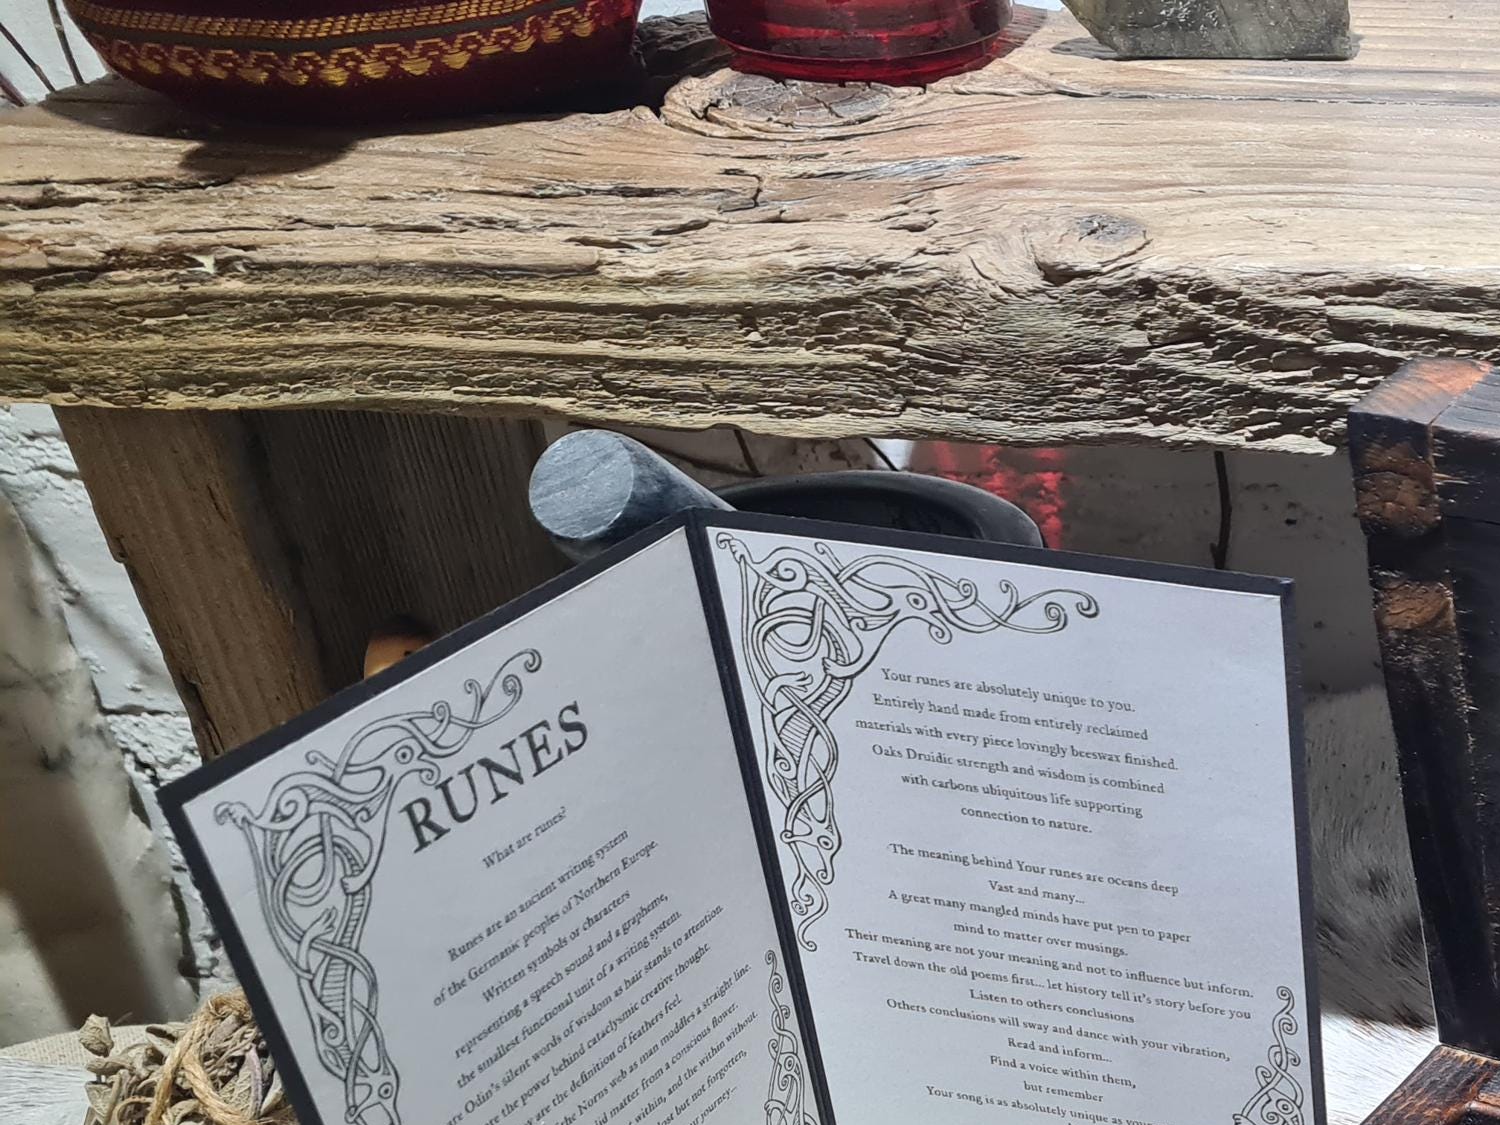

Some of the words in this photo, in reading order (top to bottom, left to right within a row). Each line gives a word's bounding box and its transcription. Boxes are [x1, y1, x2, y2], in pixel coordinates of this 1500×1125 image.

[871, 690, 926, 714] Entirely
[927, 698, 961, 716] hand
[962, 705, 998, 721] made
[999, 707, 1033, 726] from
[1033, 716, 1084, 735] entirely
[1086, 721, 1150, 741] reclaimed
[880, 665, 913, 683] Your
[915, 674, 952, 689] runes
[953, 679, 974, 691] are
[975, 678, 1041, 704] absolutely
[1042, 689, 1088, 708] unique
[1090, 695, 1106, 708] to
[1106, 698, 1137, 713] you.
[855, 717, 914, 735] materials
[914, 722, 945, 739] with
[945, 730, 981, 747] every
[982, 732, 1015, 749] piece
[1016, 735, 1069, 759] lovingly
[1069, 742, 1122, 763] beeswax
[1124, 750, 1180, 771] finished.
[398, 700, 588, 854] RUNES
[900, 771, 930, 787] with
[931, 776, 981, 794] carbons
[981, 781, 1049, 803] ubiquitous
[1050, 790, 1073, 806] life
[1074, 797, 1145, 820] supporting
[482, 843, 516, 869] What
[515, 832, 533, 850] are
[534, 805, 567, 837] runes?
[960, 805, 1031, 825] connection
[1031, 814, 1047, 827] to
[1048, 818, 1094, 834] nature.
[447, 932, 485, 962] Runes
[485, 920, 503, 938] are
[504, 909, 518, 924] an
[518, 881, 558, 914] ancient
[556, 854, 596, 884] writing
[594, 830, 629, 860] system
[888, 841, 916, 856] The
[917, 847, 972, 867] meaning
[970, 851, 1015, 870] behind
[1015, 857, 1048, 875] Your
[1049, 866, 1085, 880] runes
[1085, 871, 1106, 883] are
[1107, 874, 1150, 890] oceans
[1150, 878, 1180, 897] deep
[988, 877, 1016, 894] Vast
[1017, 884, 1040, 897] and
[1042, 888, 1086, 905] many...
[433, 987, 446, 1007] of
[447, 977, 468, 997] the
[467, 939, 521, 981] Germanic
[522, 911, 561, 948] peoples
[561, 896, 573, 915] of
[571, 866, 622, 906] Northern
[620, 840, 659, 871] Europe.
[481, 968, 527, 1003] Written
[526, 936, 569, 973] symbols
[568, 927, 580, 941] or
[582, 890, 631, 932] characters
[844, 925, 880, 942] Their
[881, 933, 934, 952] meaning
[933, 941, 953, 953] are
[954, 944, 977, 956] not
[977, 947, 1007, 961] your
[1007, 951, 1061, 971] meaning
[1061, 958, 1084, 972] and
[1085, 963, 1108, 976] not
[1109, 966, 1124, 978] to
[1125, 966, 1182, 987] influence
[1183, 975, 1205, 991] but
[1207, 979, 1255, 998] inform.
[851, 948, 893, 966] Travel
[893, 953, 926, 971] down
[927, 959, 948, 973] the
[949, 963, 969, 977] old
[970, 968, 1010, 983] poems
[1011, 970, 1046, 989] first...
[1046, 976, 1064, 991] let
[1065, 979, 1109, 1001] history
[1110, 987, 1132, 1002] tell
[1132, 989, 1153, 1005] it's
[1154, 996, 1187, 1012] story
[1187, 997, 1227, 1016] before
[1228, 1007, 1253, 1020] you
[500, 1099, 519, 1118] the
[520, 1072, 551, 1107] power
[550, 1042, 586, 1077] behind
[586, 1001, 640, 1050] cataclysmic
[640, 973, 674, 1006] creative
[674, 943, 711, 977] thought.
[886, 996, 928, 1014] Others
[928, 1005, 998, 1024] conclusions
[998, 1013, 1021, 1028] will
[1022, 1019, 1050, 1034] sway
[1052, 1022, 1075, 1036] and
[1075, 1024, 1110, 1041] dance
[1111, 1031, 1140, 1046] with
[1141, 1037, 1170, 1051] your
[1171, 1040, 1232, 1062] vibration,
[969, 986, 1009, 1004] Listen
[1010, 995, 1025, 1006] to
[1025, 997, 1065, 1013] others
[1065, 1004, 1136, 1024] conclusions
[989, 1053, 1019, 1069] Find
[1019, 1060, 1028, 1070] a
[1028, 1061, 1060, 1075] voice
[1060, 1065, 1100, 1082] within
[1101, 1071, 1138, 1089] them,
[1007, 1035, 1037, 1051] Read
[1038, 1041, 1061, 1055] and
[1061, 1042, 1114, 1063] inform...
[925, 1083, 955, 1099] Your
[956, 1090, 985, 1106] song
[984, 1095, 996, 1105] is
[996, 1097, 1010, 1107] as
[1011, 1097, 1068, 1119] absolutely
[1069, 1108, 1110, 1124] unique
[1111, 1115, 1124, 1125] as
[1023, 1078, 1044, 1093] but
[1045, 1085, 1105, 1103] remember
